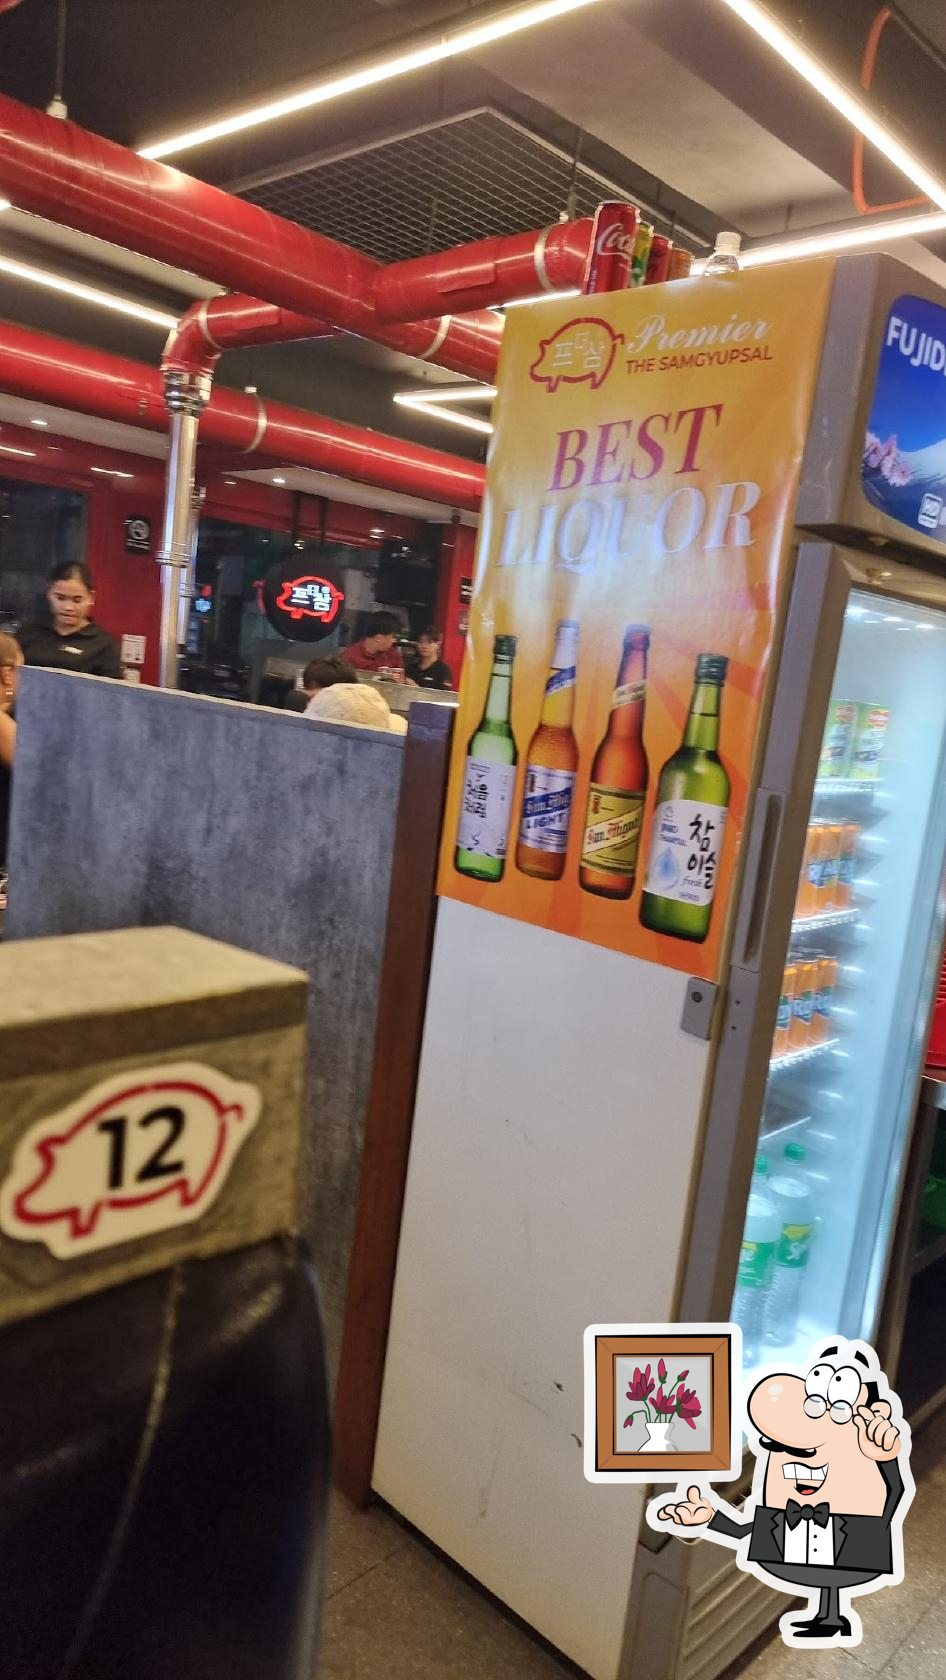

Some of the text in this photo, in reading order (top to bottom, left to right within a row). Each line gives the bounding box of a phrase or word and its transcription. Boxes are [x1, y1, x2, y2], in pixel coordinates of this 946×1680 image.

[627, 313, 772, 353] Premier
[625, 346, 773, 374] THE SAMGYUPSAL
[546, 404, 724, 492] BEST
[496, 481, 762, 576] LIQUOR
[526, 812, 568, 829] LIGHT
[689, 813, 715, 852] 참
[97, 1105, 187, 1190] 12
